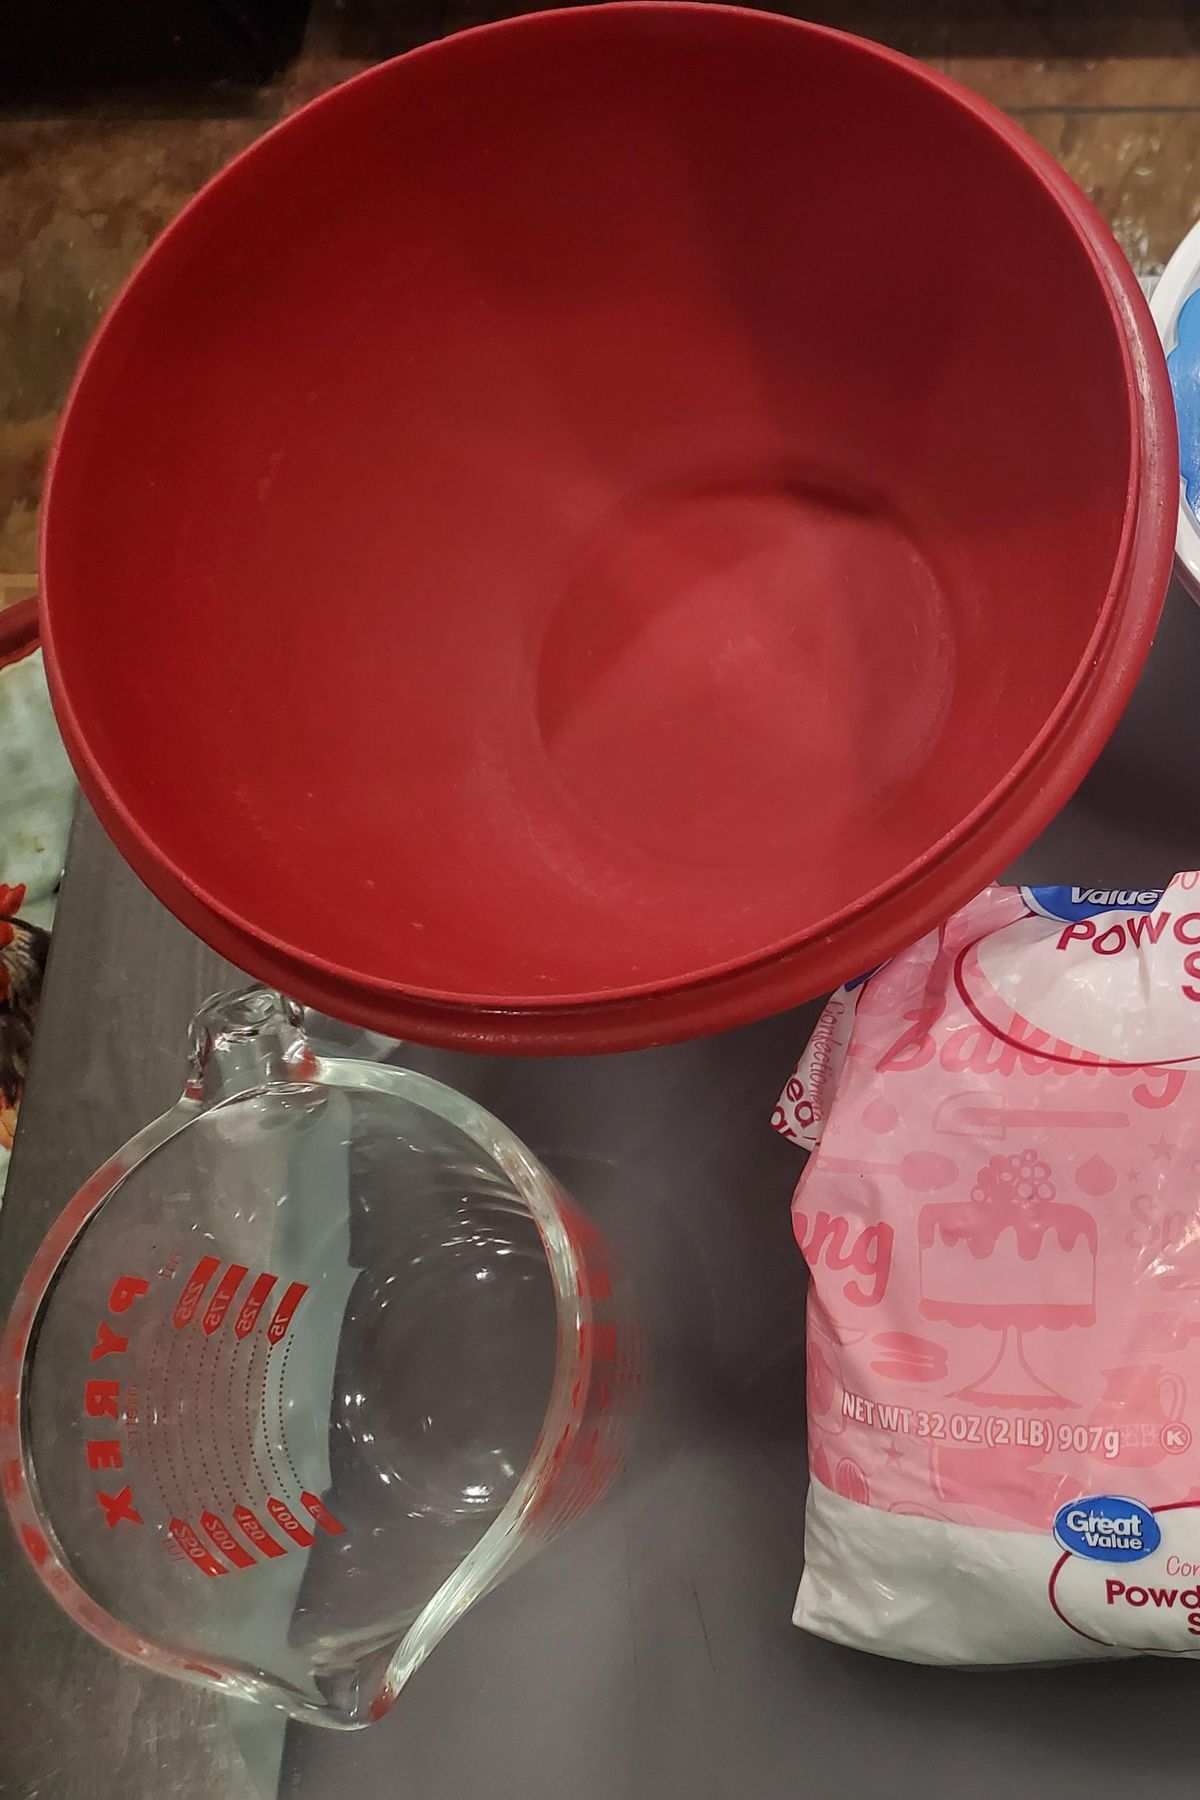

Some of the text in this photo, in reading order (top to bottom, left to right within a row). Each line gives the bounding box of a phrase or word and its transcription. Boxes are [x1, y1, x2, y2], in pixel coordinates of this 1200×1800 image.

[1071, 886, 1158, 906] Value
[842, 1390, 1120, 1458] NET WT 32 OZ (2 LB) 907g
[1066, 1510, 1142, 1536] Great
[1084, 1533, 1143, 1550] Value
